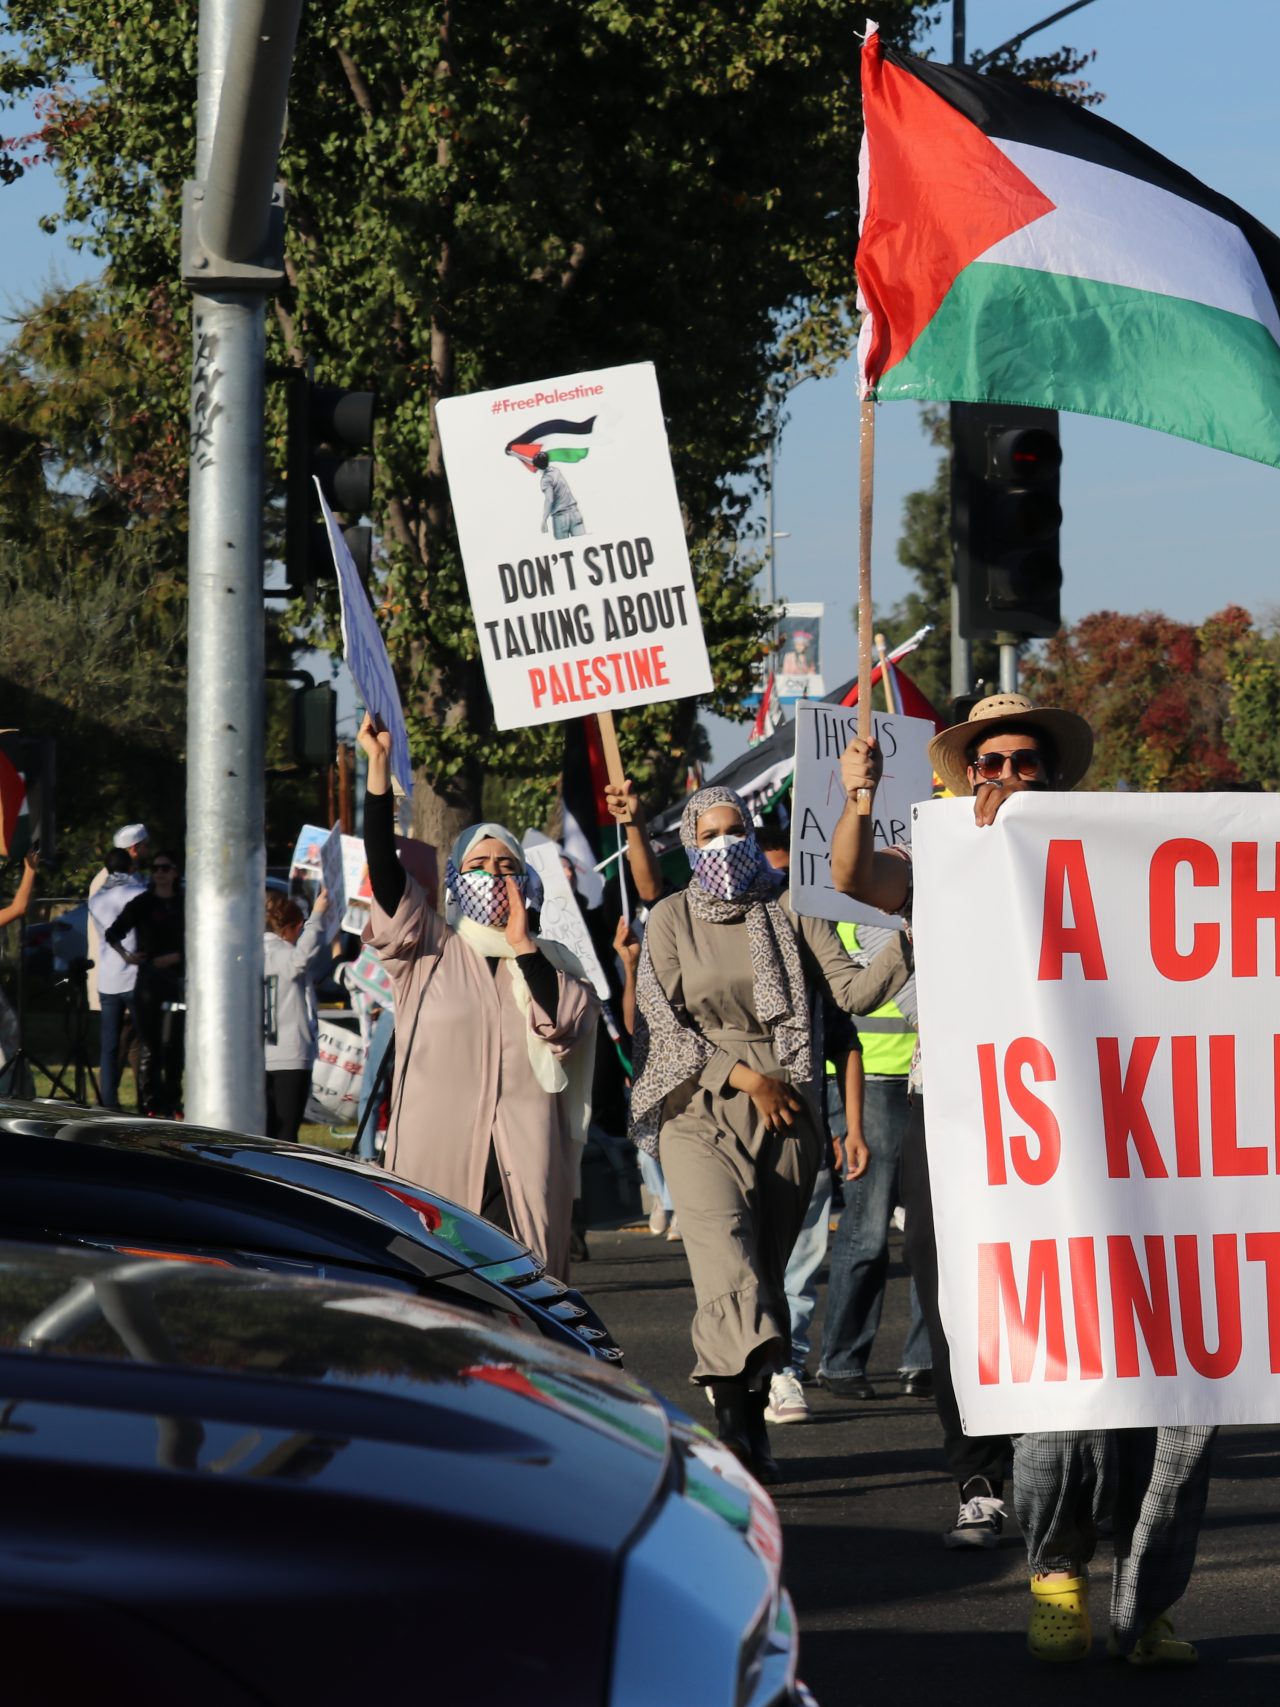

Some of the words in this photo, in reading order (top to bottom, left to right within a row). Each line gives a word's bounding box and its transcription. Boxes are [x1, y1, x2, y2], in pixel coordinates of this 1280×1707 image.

[491, 384, 604, 414] #FreePalestine
[497, 551, 576, 604] DON'T
[583, 537, 655, 586] STOP
[484, 603, 594, 661] TALKING
[602, 585, 688, 642] ABOUT
[528, 645, 670, 708] PALESTINE
[874, 718, 897, 758] IS
[1037, 838, 1109, 981] A
[976, 1036, 1061, 1187] IS
